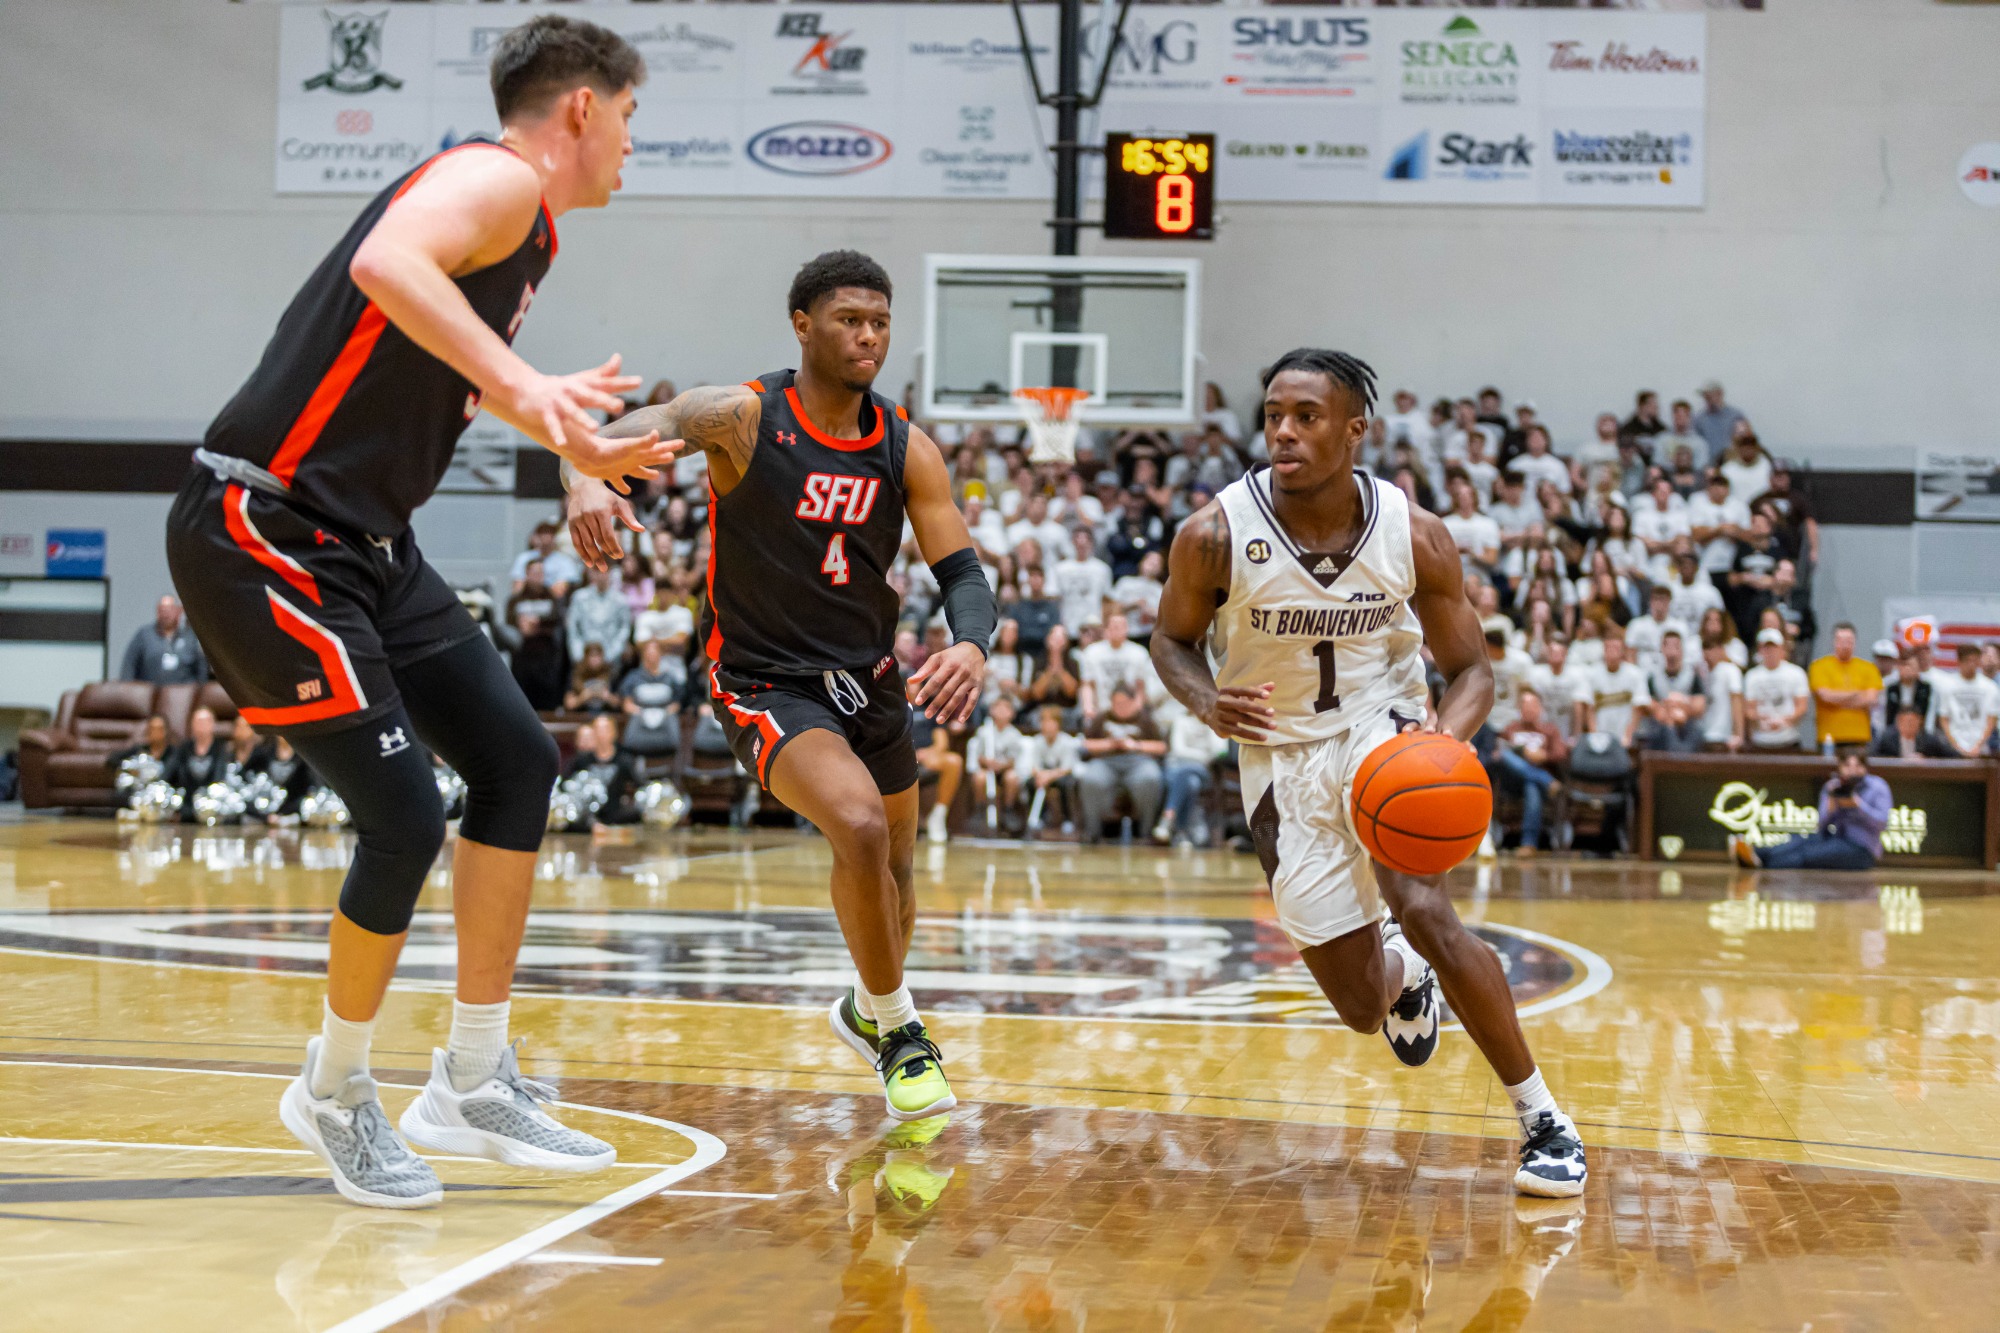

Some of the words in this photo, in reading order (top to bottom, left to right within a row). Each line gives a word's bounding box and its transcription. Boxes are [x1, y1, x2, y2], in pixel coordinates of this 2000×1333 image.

[1233, 17, 1370, 46] SHULTS
[1401, 41, 1519, 67] SENECA
[1548, 40, 1594, 71] Tim
[1599, 40, 1699, 73] Hortons
[282, 137, 423, 163] Community
[765, 136, 873, 158] mazza
[1437, 131, 1534, 167] Stark
[1156, 174, 1194, 233] 8
[796, 471, 881, 525] SFU
[821, 532, 850, 586] 4
[1248, 543, 1270, 561] 31
[1312, 566, 1339, 575] adidas
[1345, 592, 1386, 603] A10
[1251, 608, 1271, 635] ST.
[1275, 601, 1400, 637] BONAVENTURE
[296, 678, 322, 701] SFU
[1312, 640, 1341, 715] 1
